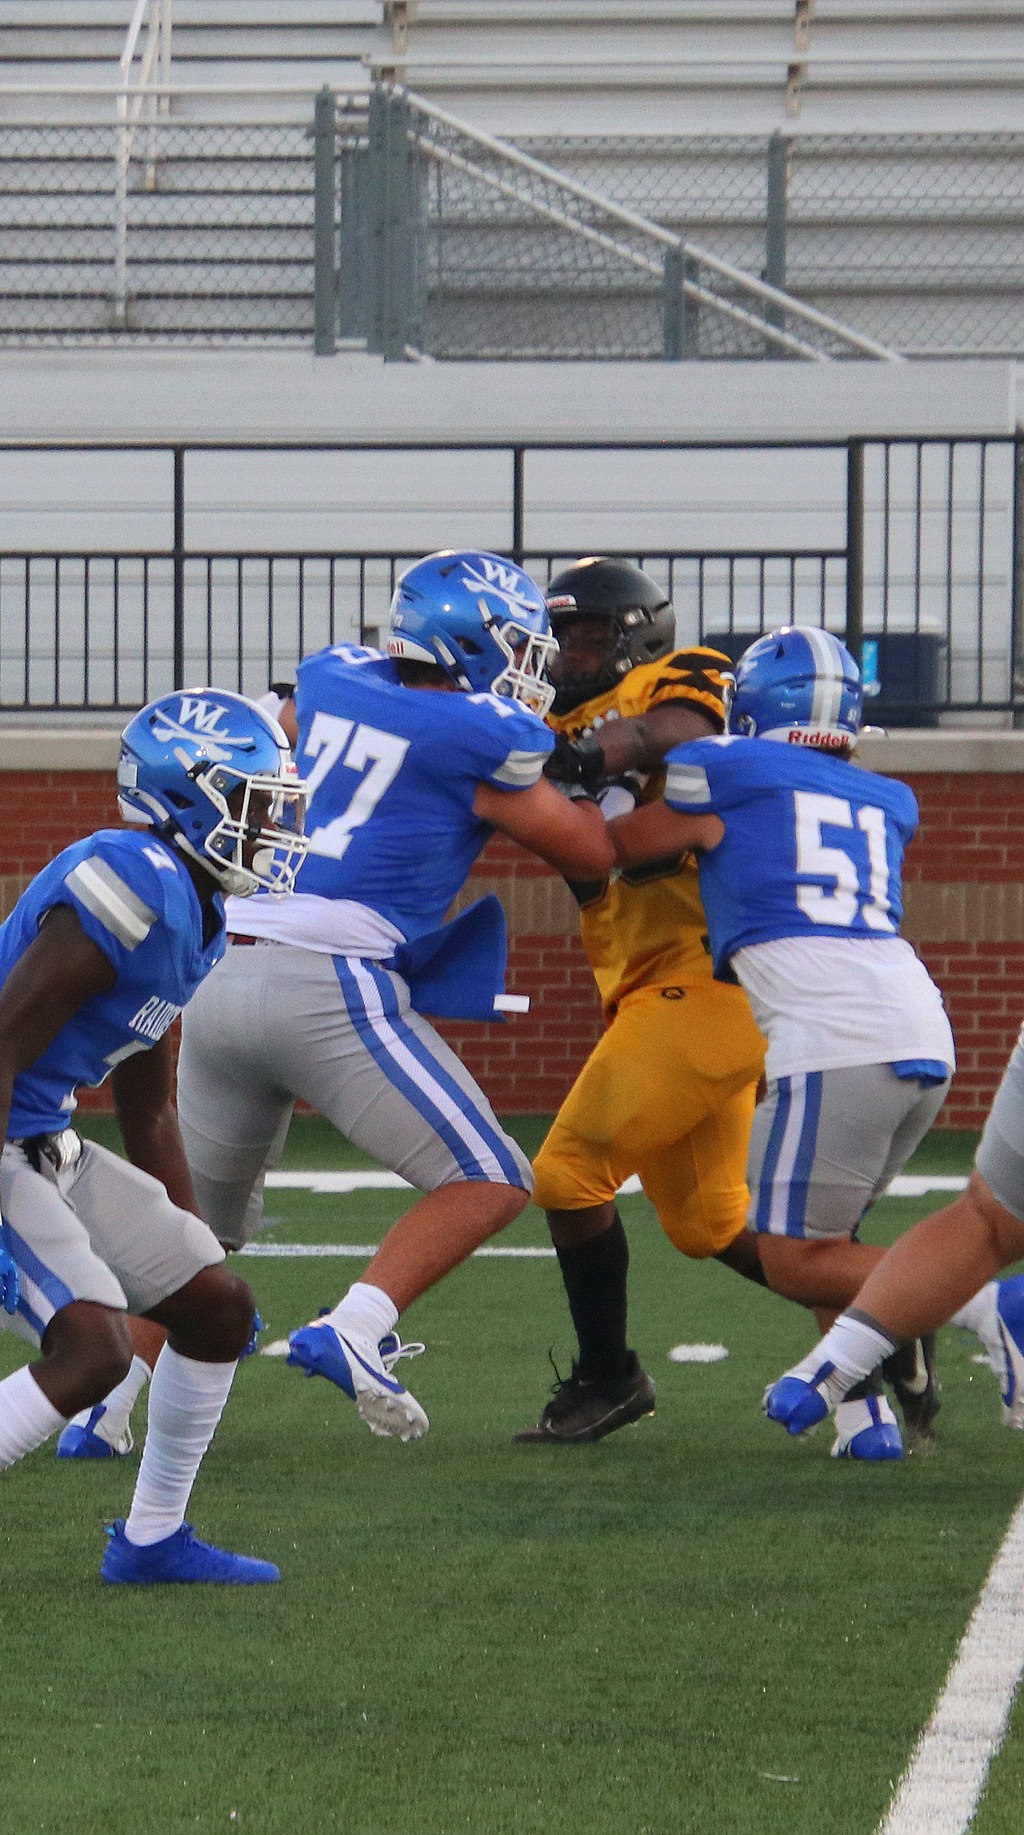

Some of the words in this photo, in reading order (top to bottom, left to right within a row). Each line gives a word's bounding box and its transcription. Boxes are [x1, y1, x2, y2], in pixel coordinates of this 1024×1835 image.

[304, 711, 411, 860] 77
[788, 731, 849, 749] Riddell
[794, 789, 896, 933] 51
